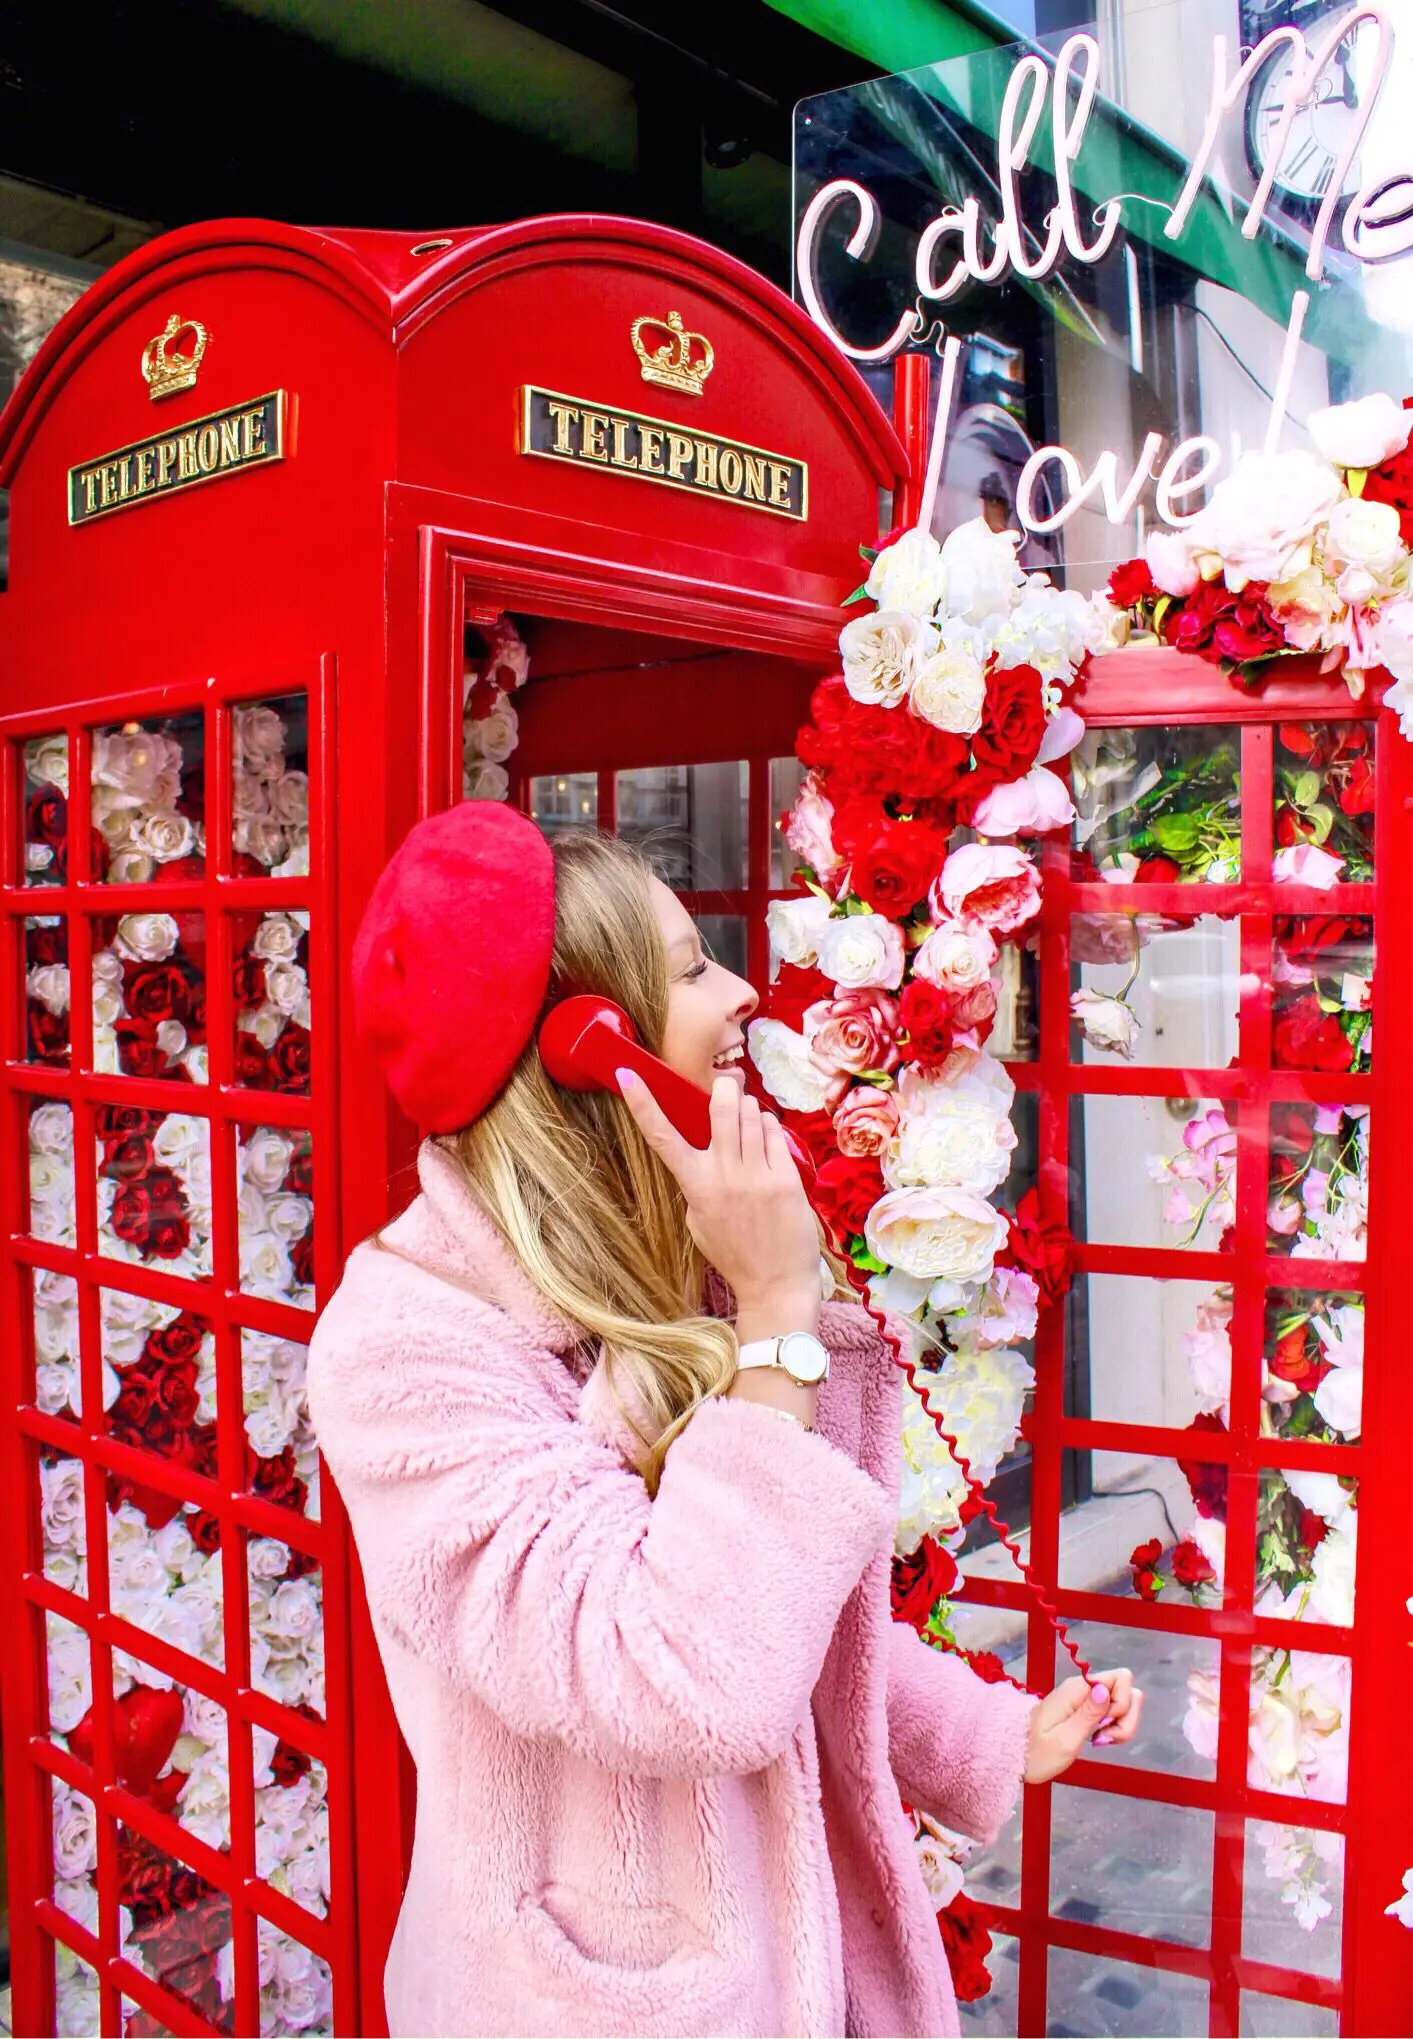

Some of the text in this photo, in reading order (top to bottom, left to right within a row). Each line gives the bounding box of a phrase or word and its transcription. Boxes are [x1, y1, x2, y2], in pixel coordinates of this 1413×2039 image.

[797, 33, 1122, 361] Call
[81, 406, 267, 514] TELEPHONE
[549, 401, 792, 509] TELEPHONE
